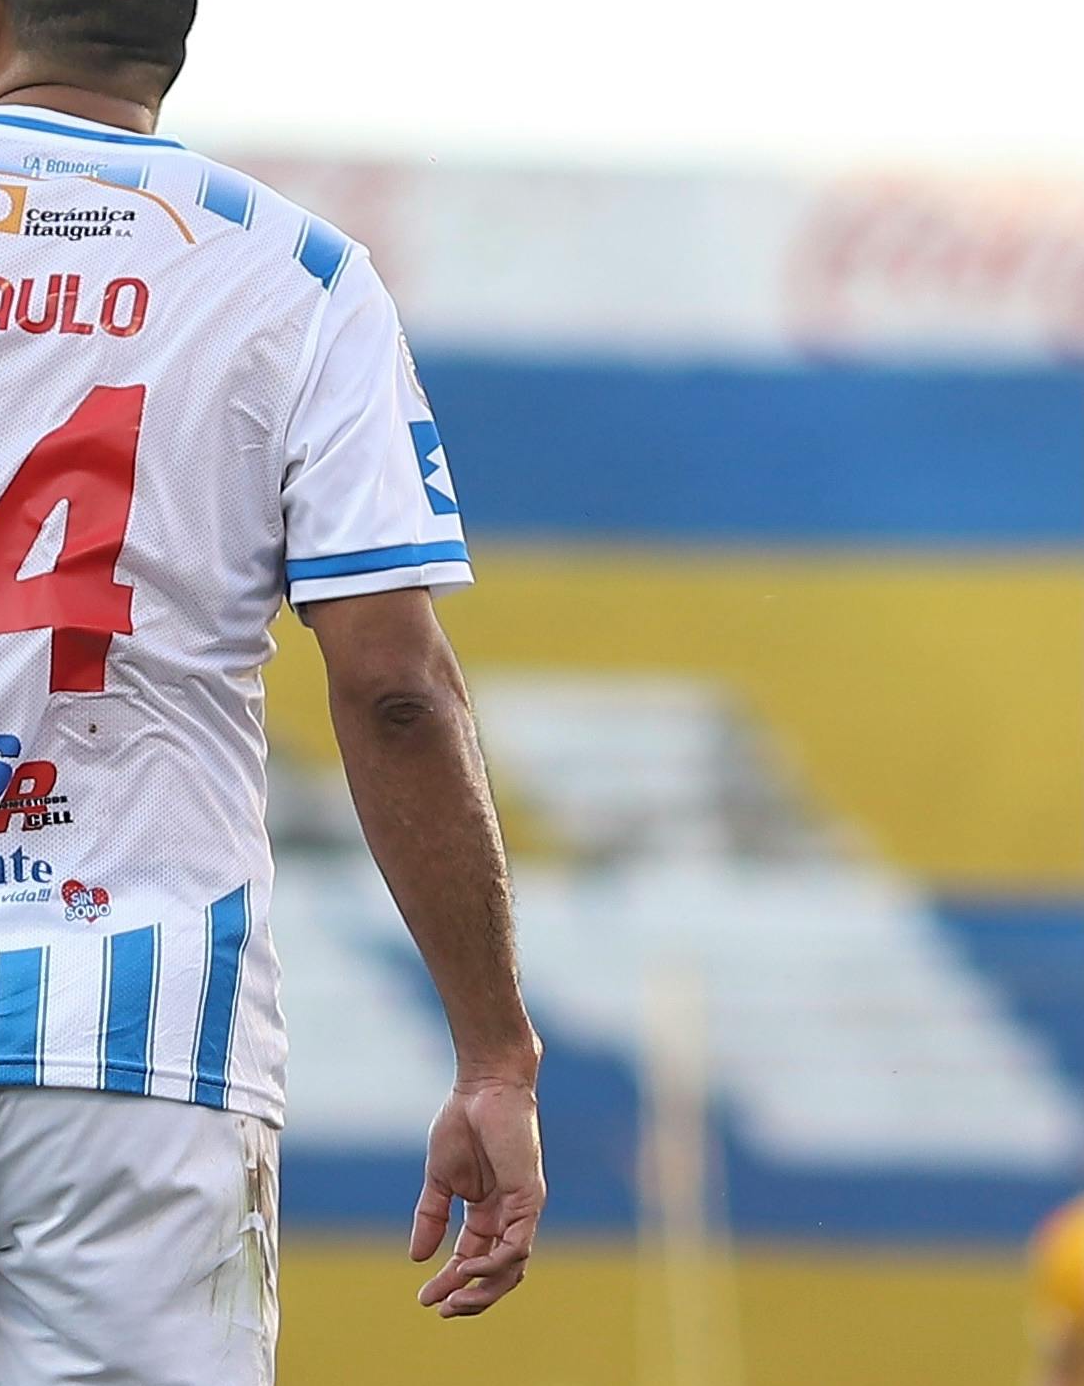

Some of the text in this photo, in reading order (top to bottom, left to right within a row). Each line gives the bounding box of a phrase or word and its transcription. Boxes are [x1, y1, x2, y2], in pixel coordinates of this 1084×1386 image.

[27, 811, 73, 827] CELL
[70, 890, 94, 907] SIN
[64, 903, 112, 922] SODIO
